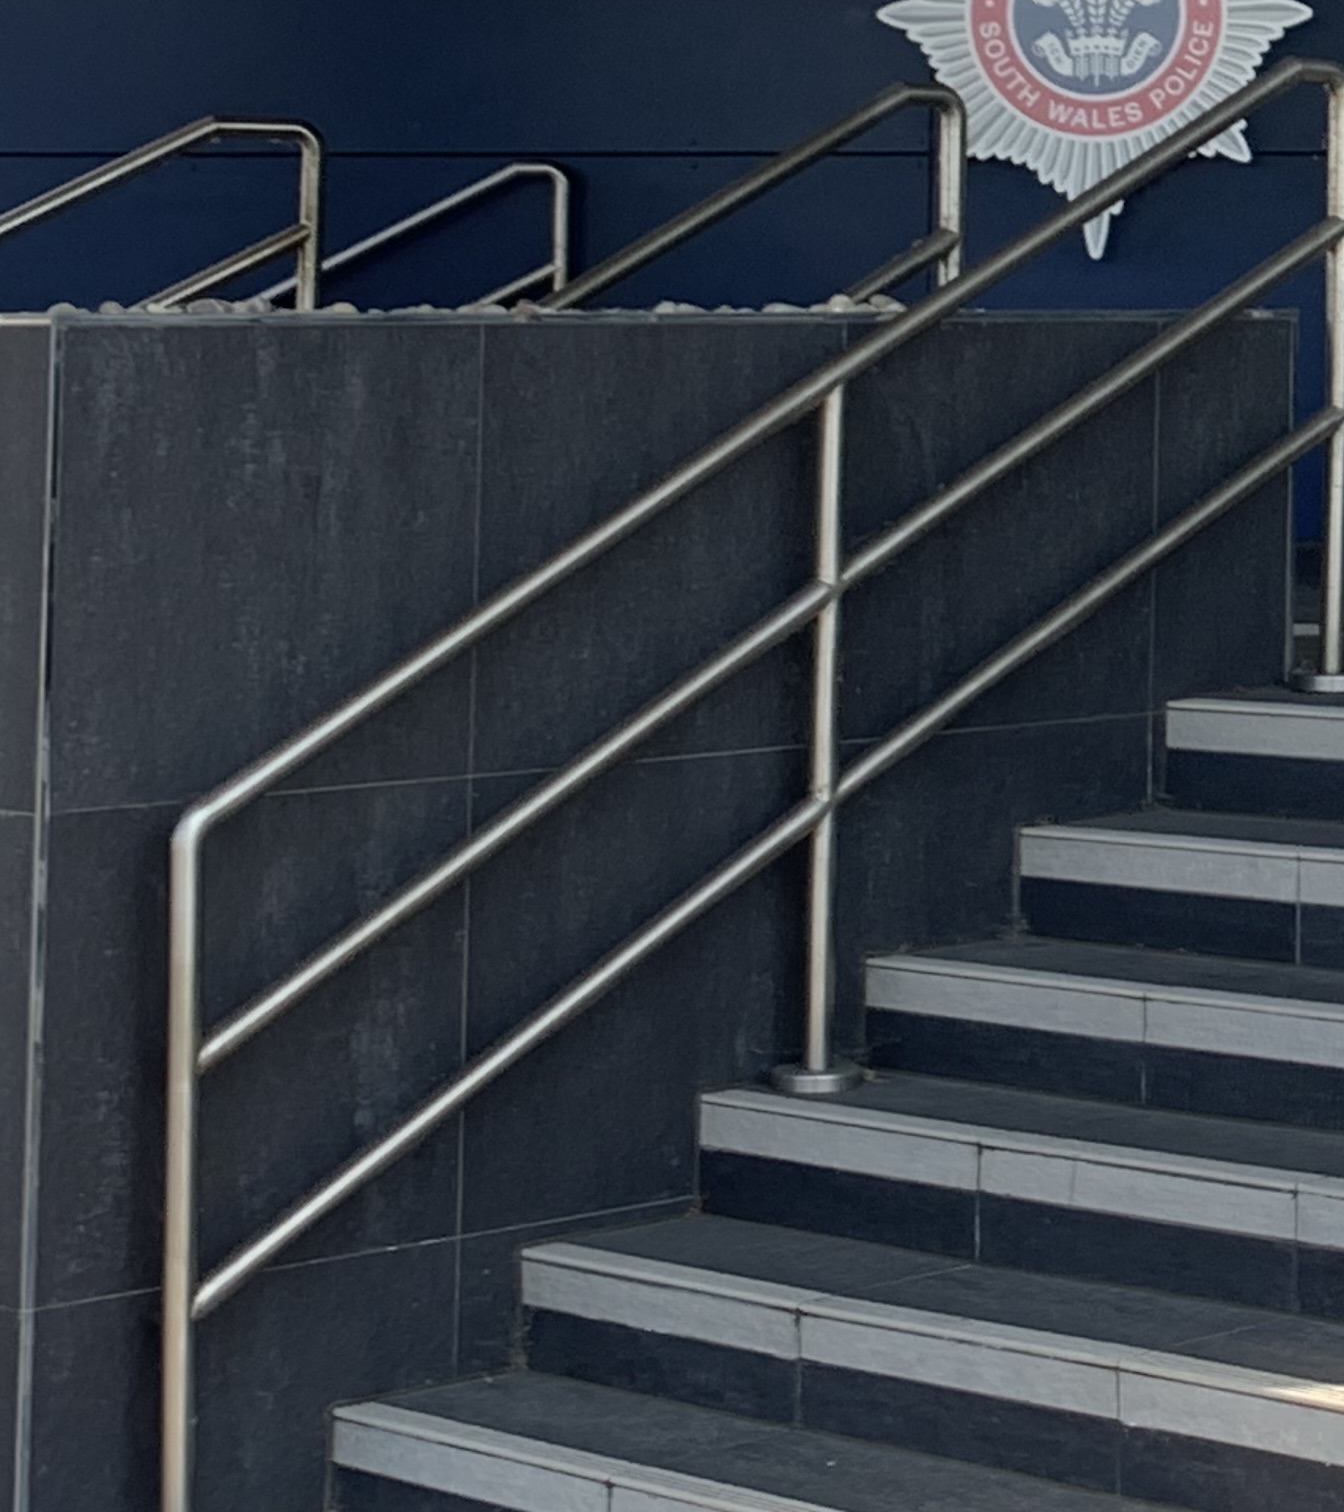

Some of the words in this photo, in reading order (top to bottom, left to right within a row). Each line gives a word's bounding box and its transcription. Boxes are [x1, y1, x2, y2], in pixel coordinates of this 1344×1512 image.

[980, 21, 1040, 108] SOUTH
[1047, 101, 1144, 130] WALES
[1149, 20, 1215, 110] POLICE
